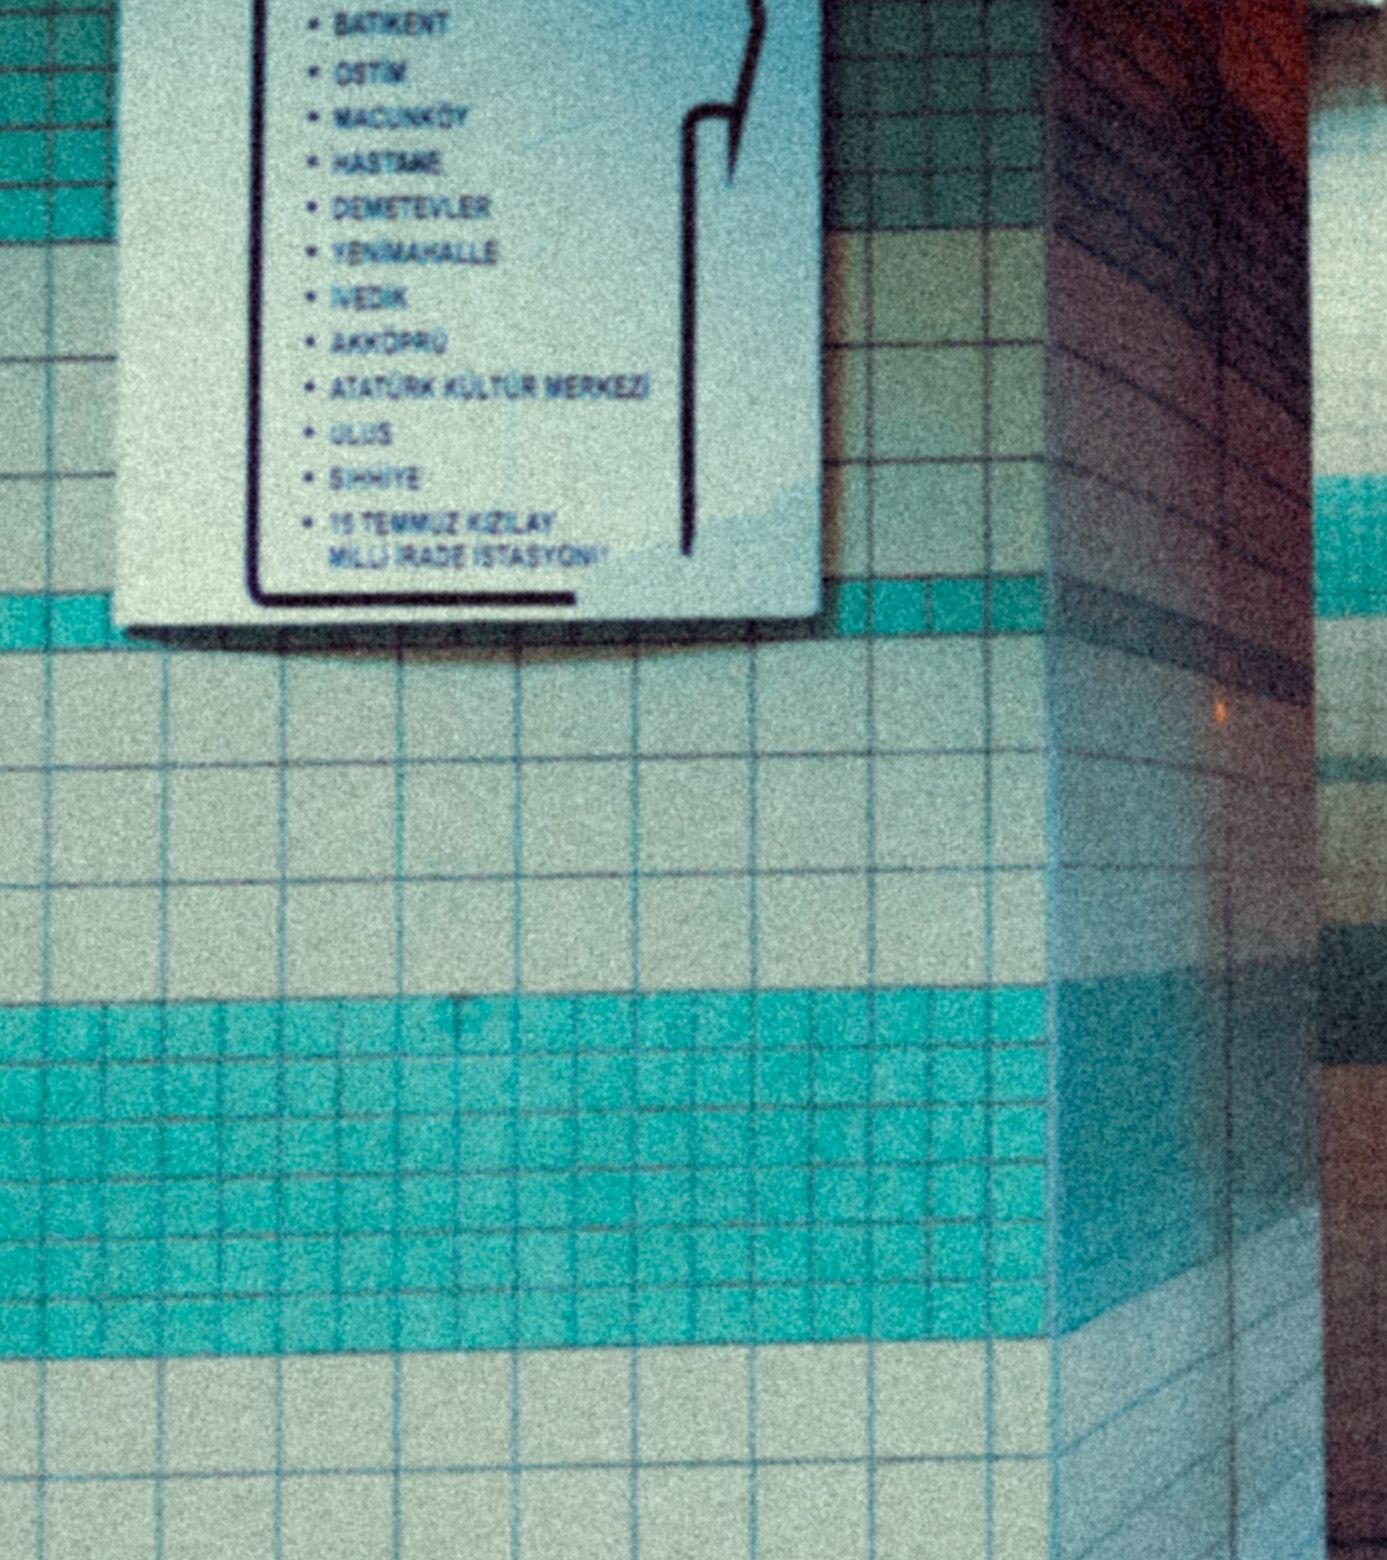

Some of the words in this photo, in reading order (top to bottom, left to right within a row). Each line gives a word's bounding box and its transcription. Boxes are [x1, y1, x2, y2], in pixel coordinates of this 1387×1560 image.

[334, 10, 450, 38] BATIKENT
[333, 101, 469, 130] MACUNKÖY
[333, 150, 441, 175] HASTANE
[332, 194, 491, 221] DEMETEVLER
[330, 328, 447, 356] AKKÖPRÜ
[330, 373, 434, 401] ATATÜRK
[443, 371, 538, 401] KÜLTÜR
[330, 420, 393, 448] ULUS
[330, 511, 354, 536] 15
[362, 510, 459, 537] TEMMUZ
[466, 510, 557, 536] KIZILAY
